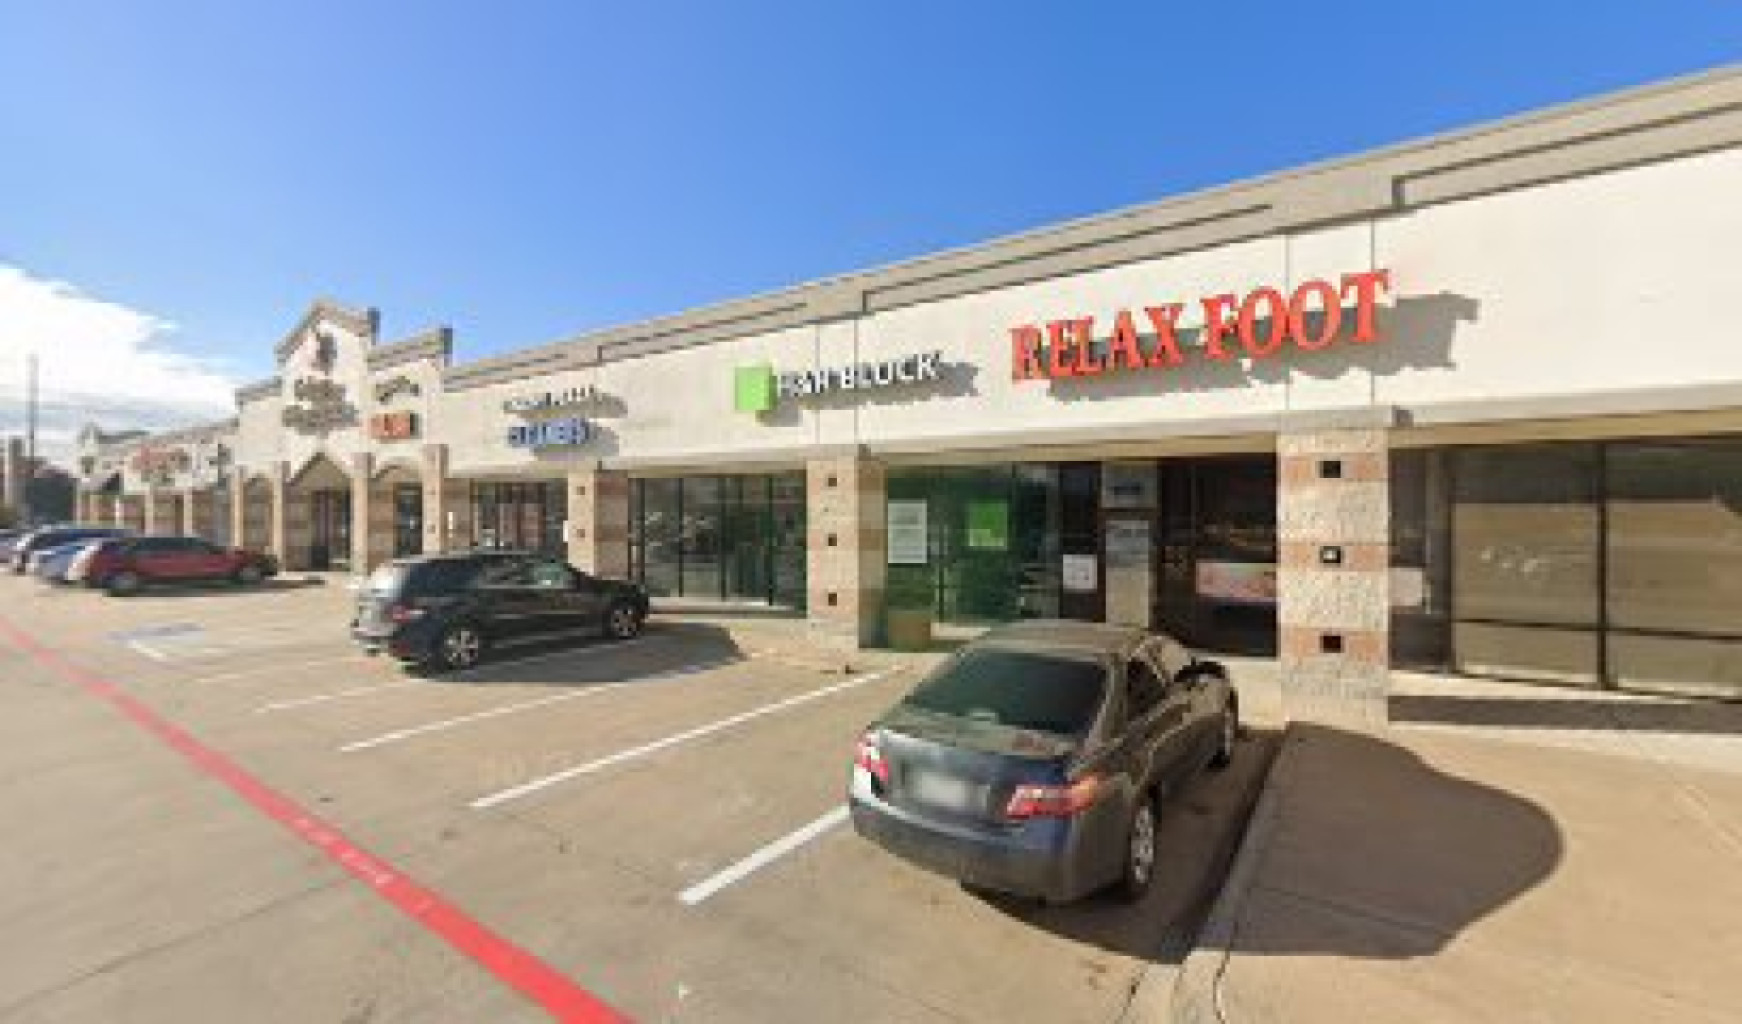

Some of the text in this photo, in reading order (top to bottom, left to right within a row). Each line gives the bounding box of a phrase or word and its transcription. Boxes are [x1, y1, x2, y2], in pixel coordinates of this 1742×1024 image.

[1010, 269, 1390, 381] RELAX FOOT
[841, 353, 937, 388] BLOCK
